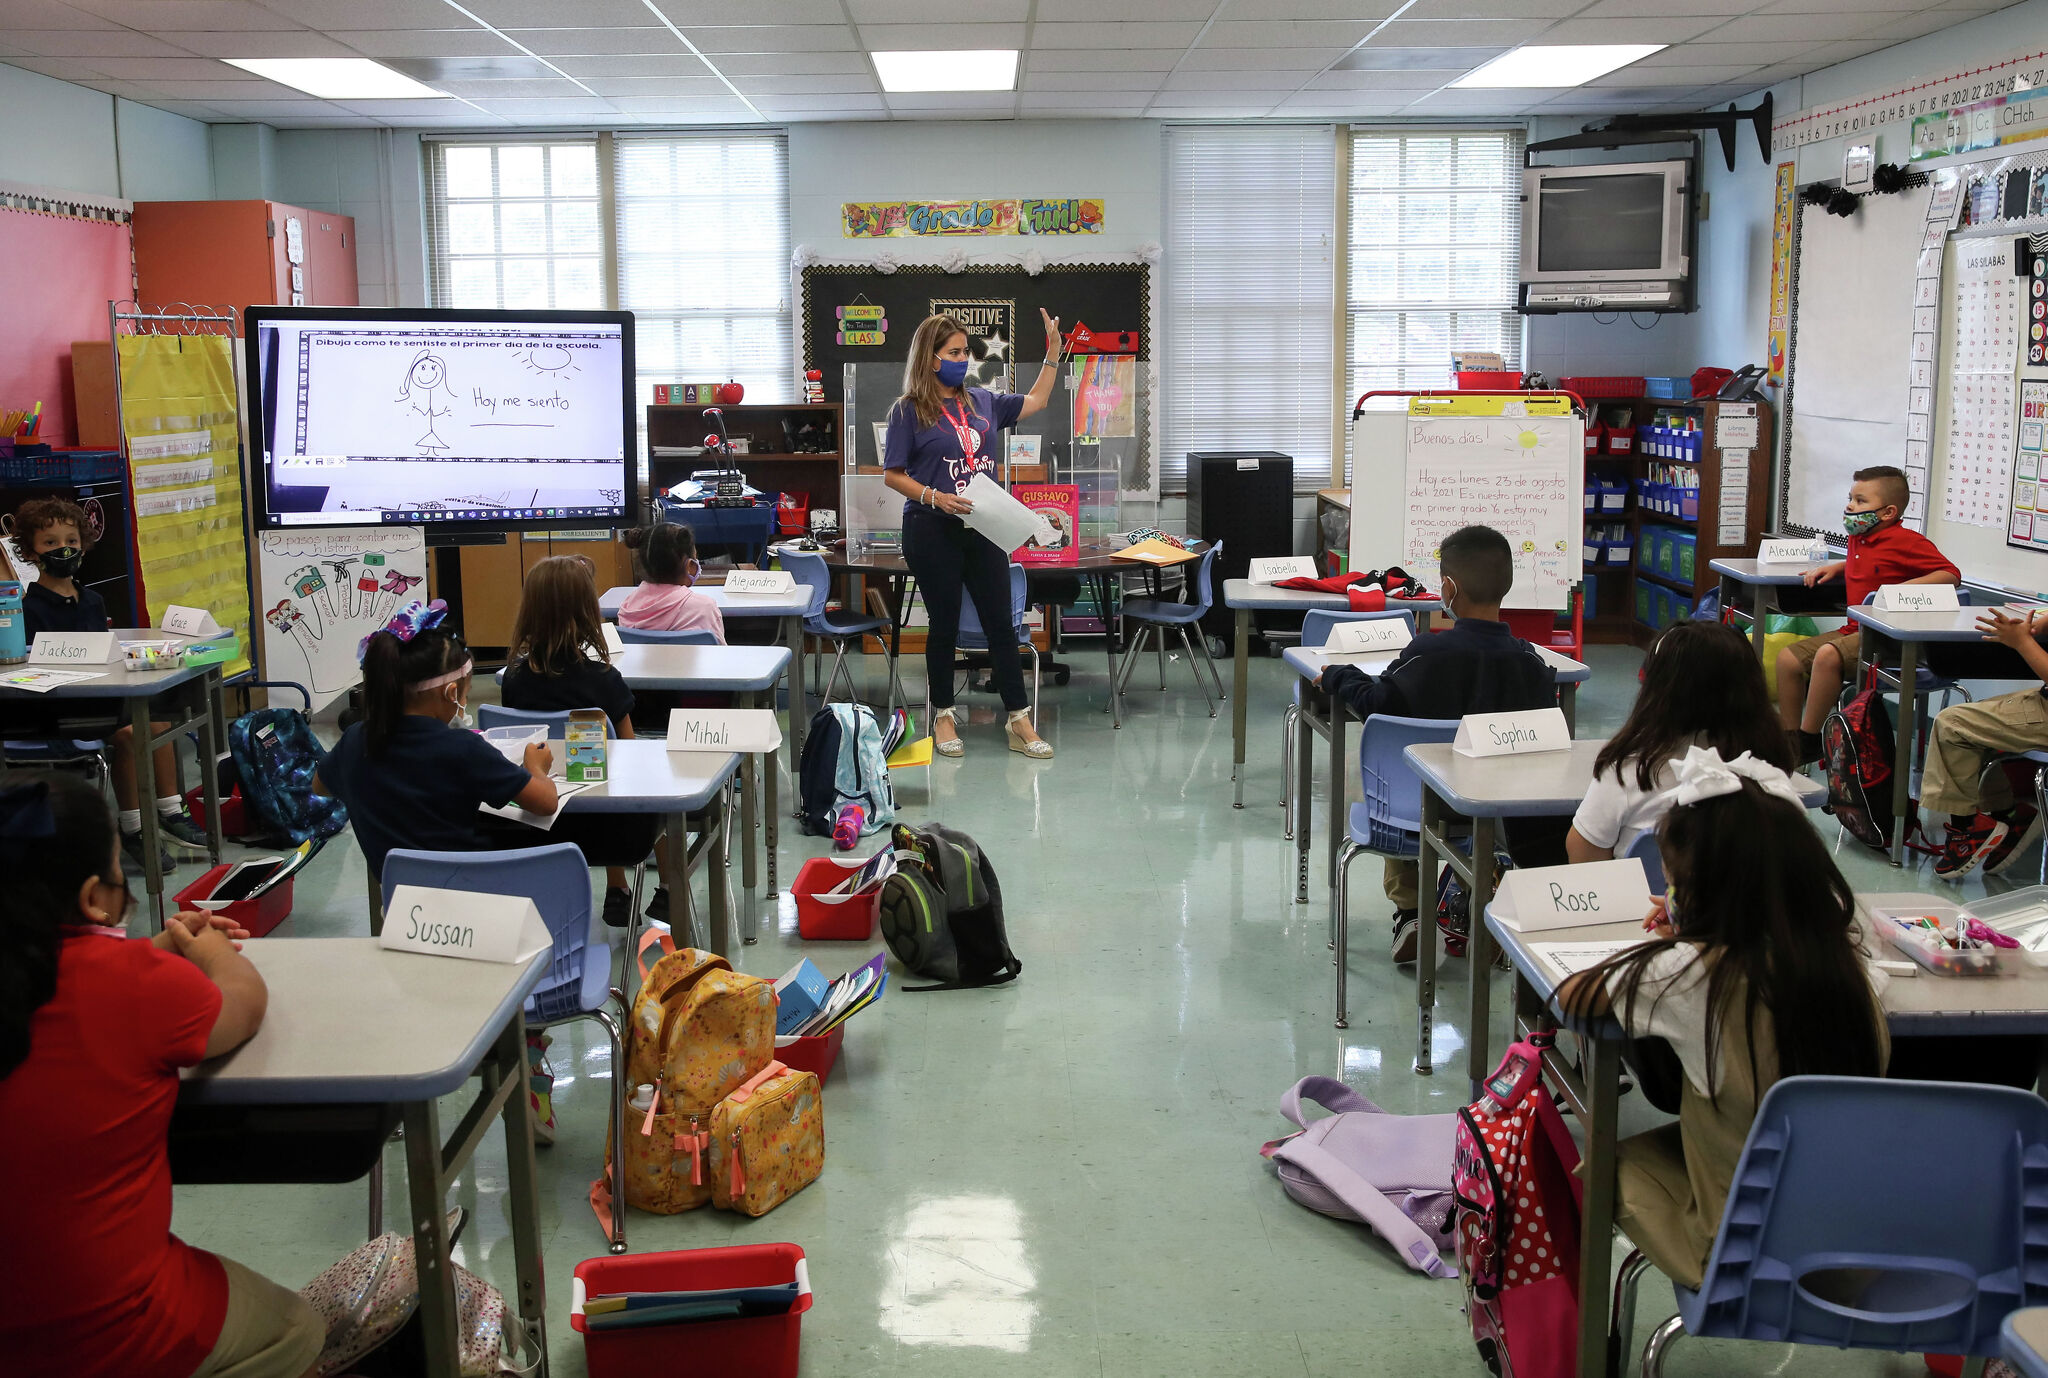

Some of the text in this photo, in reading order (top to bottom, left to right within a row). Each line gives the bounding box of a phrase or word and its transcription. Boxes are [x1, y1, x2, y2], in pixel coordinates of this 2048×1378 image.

[1852, 118, 1859, 130] 10
[1861, 116, 1866, 127] 11
[1870, 113, 1875, 125] 12
[1880, 110, 1885, 123] 13
[1888, 108, 1894, 120] 14
[1899, 106, 1905, 118] 15
[1909, 103, 1915, 115] 16
[1920, 100, 1926, 112] 17
[1930, 97, 1936, 110] 18
[1942, 94, 1949, 107] 19
[1952, 90, 1960, 105] 20
[1962, 89, 1968, 102] 21
[1972, 85, 1981, 100] 22
[1984, 82, 1993, 97] 23
[1995, 80, 2005, 94] 24
[2007, 76, 2016, 91] 25
[2033, 70, 2044, 86] 27
[1921, 102, 2034, 143] Aa Bb Cc CHch
[872, 203, 907, 236] 1st
[908, 202, 993, 234] Grade
[1019, 199, 1079, 234] Fun!
[1968, 258, 1978, 268] LAS
[2036, 284, 2041, 293] 8
[2035, 305, 2042, 314] 15
[848, 333, 876, 344] CLASS
[966, 326, 989, 335] NDSET
[2032, 348, 2041, 358] 29
[473, 386, 569, 415] Hoy me siento
[1086, 389, 1115, 399] THANK
[1419, 469, 1438, 488] Hoy
[1460, 470, 1490, 485] lunes
[1496, 476, 1511, 487] 23
[1515, 475, 1527, 487] de
[1532, 472, 1565, 491] agosto
[877, 497, 885, 507] hp
[1410, 486, 1427, 497] del
[1460, 488, 1474, 500] Es
[1478, 490, 1510, 500] nuestro
[1513, 493, 1545, 504] primer
[1549, 490, 1565, 500] día
[1428, 504, 1455, 515] primer
[1461, 503, 1487, 514] grado
[1491, 504, 1500, 513] Yo
[1504, 505, 1526, 516] estoy
[1530, 507, 1547, 516] muy
[1526, 526, 1536, 535] el
[269, 530, 408, 549] 5 pasos para contar una
[314, 543, 360, 553] historia
[1409, 537, 1441, 548] día de
[1408, 549, 1432, 557] Feliz
[1263, 563, 1298, 575] Isabella
[729, 575, 776, 590] Alejandro
[317, 590, 334, 625] Escenario
[363, 593, 371, 620] Eventos
[1898, 593, 1932, 610] Angela
[171, 612, 188, 630] Grace
[1355, 625, 1398, 642] Dilan
[40, 640, 87, 658] Jackson
[685, 721, 729, 744] Mihali
[1488, 722, 1538, 750] Sophia
[1550, 882, 1600, 912] Rose
[407, 905, 473, 948] Sussan
